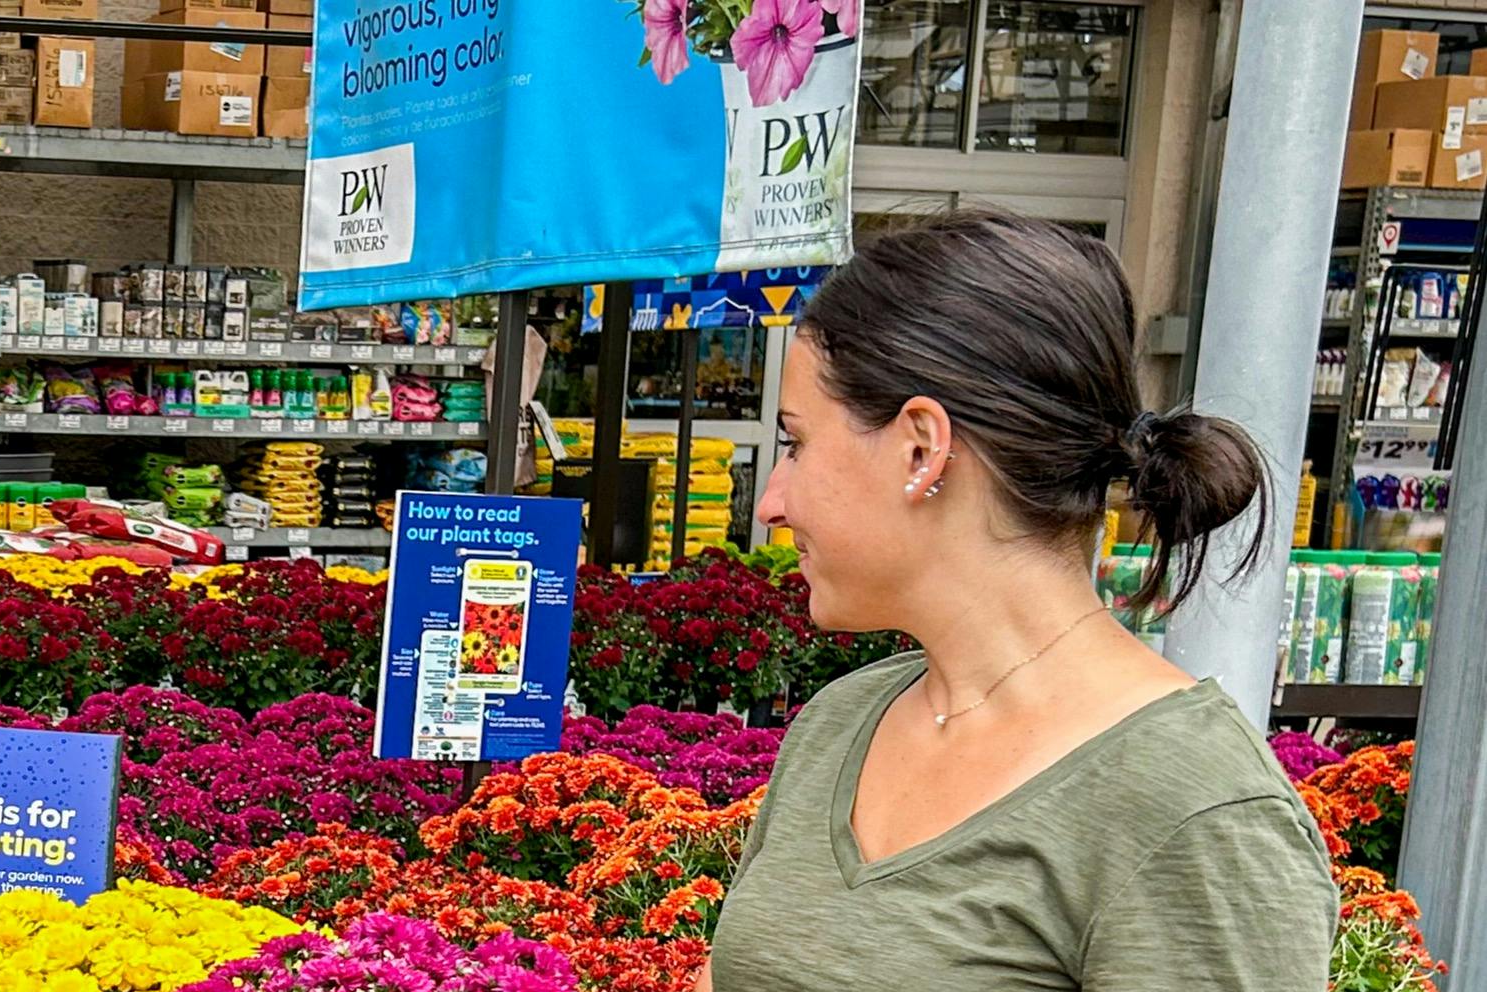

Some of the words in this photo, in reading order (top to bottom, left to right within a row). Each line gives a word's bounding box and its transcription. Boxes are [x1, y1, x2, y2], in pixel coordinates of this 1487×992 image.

[343, 0, 443, 52] vigorous,
[343, 45, 447, 98] blooming
[339, 217, 384, 236] PROVEN
[408, 501, 450, 519] How
[454, 504, 474, 522] to
[477, 505, 521, 523] read
[406, 527, 439, 541] our
[441, 525, 490, 545] plant
[494, 528, 540, 548] tags.
[27, 800, 76, 829] for
[8, 870, 53, 884] garden
[55, 875, 85, 885] now.
